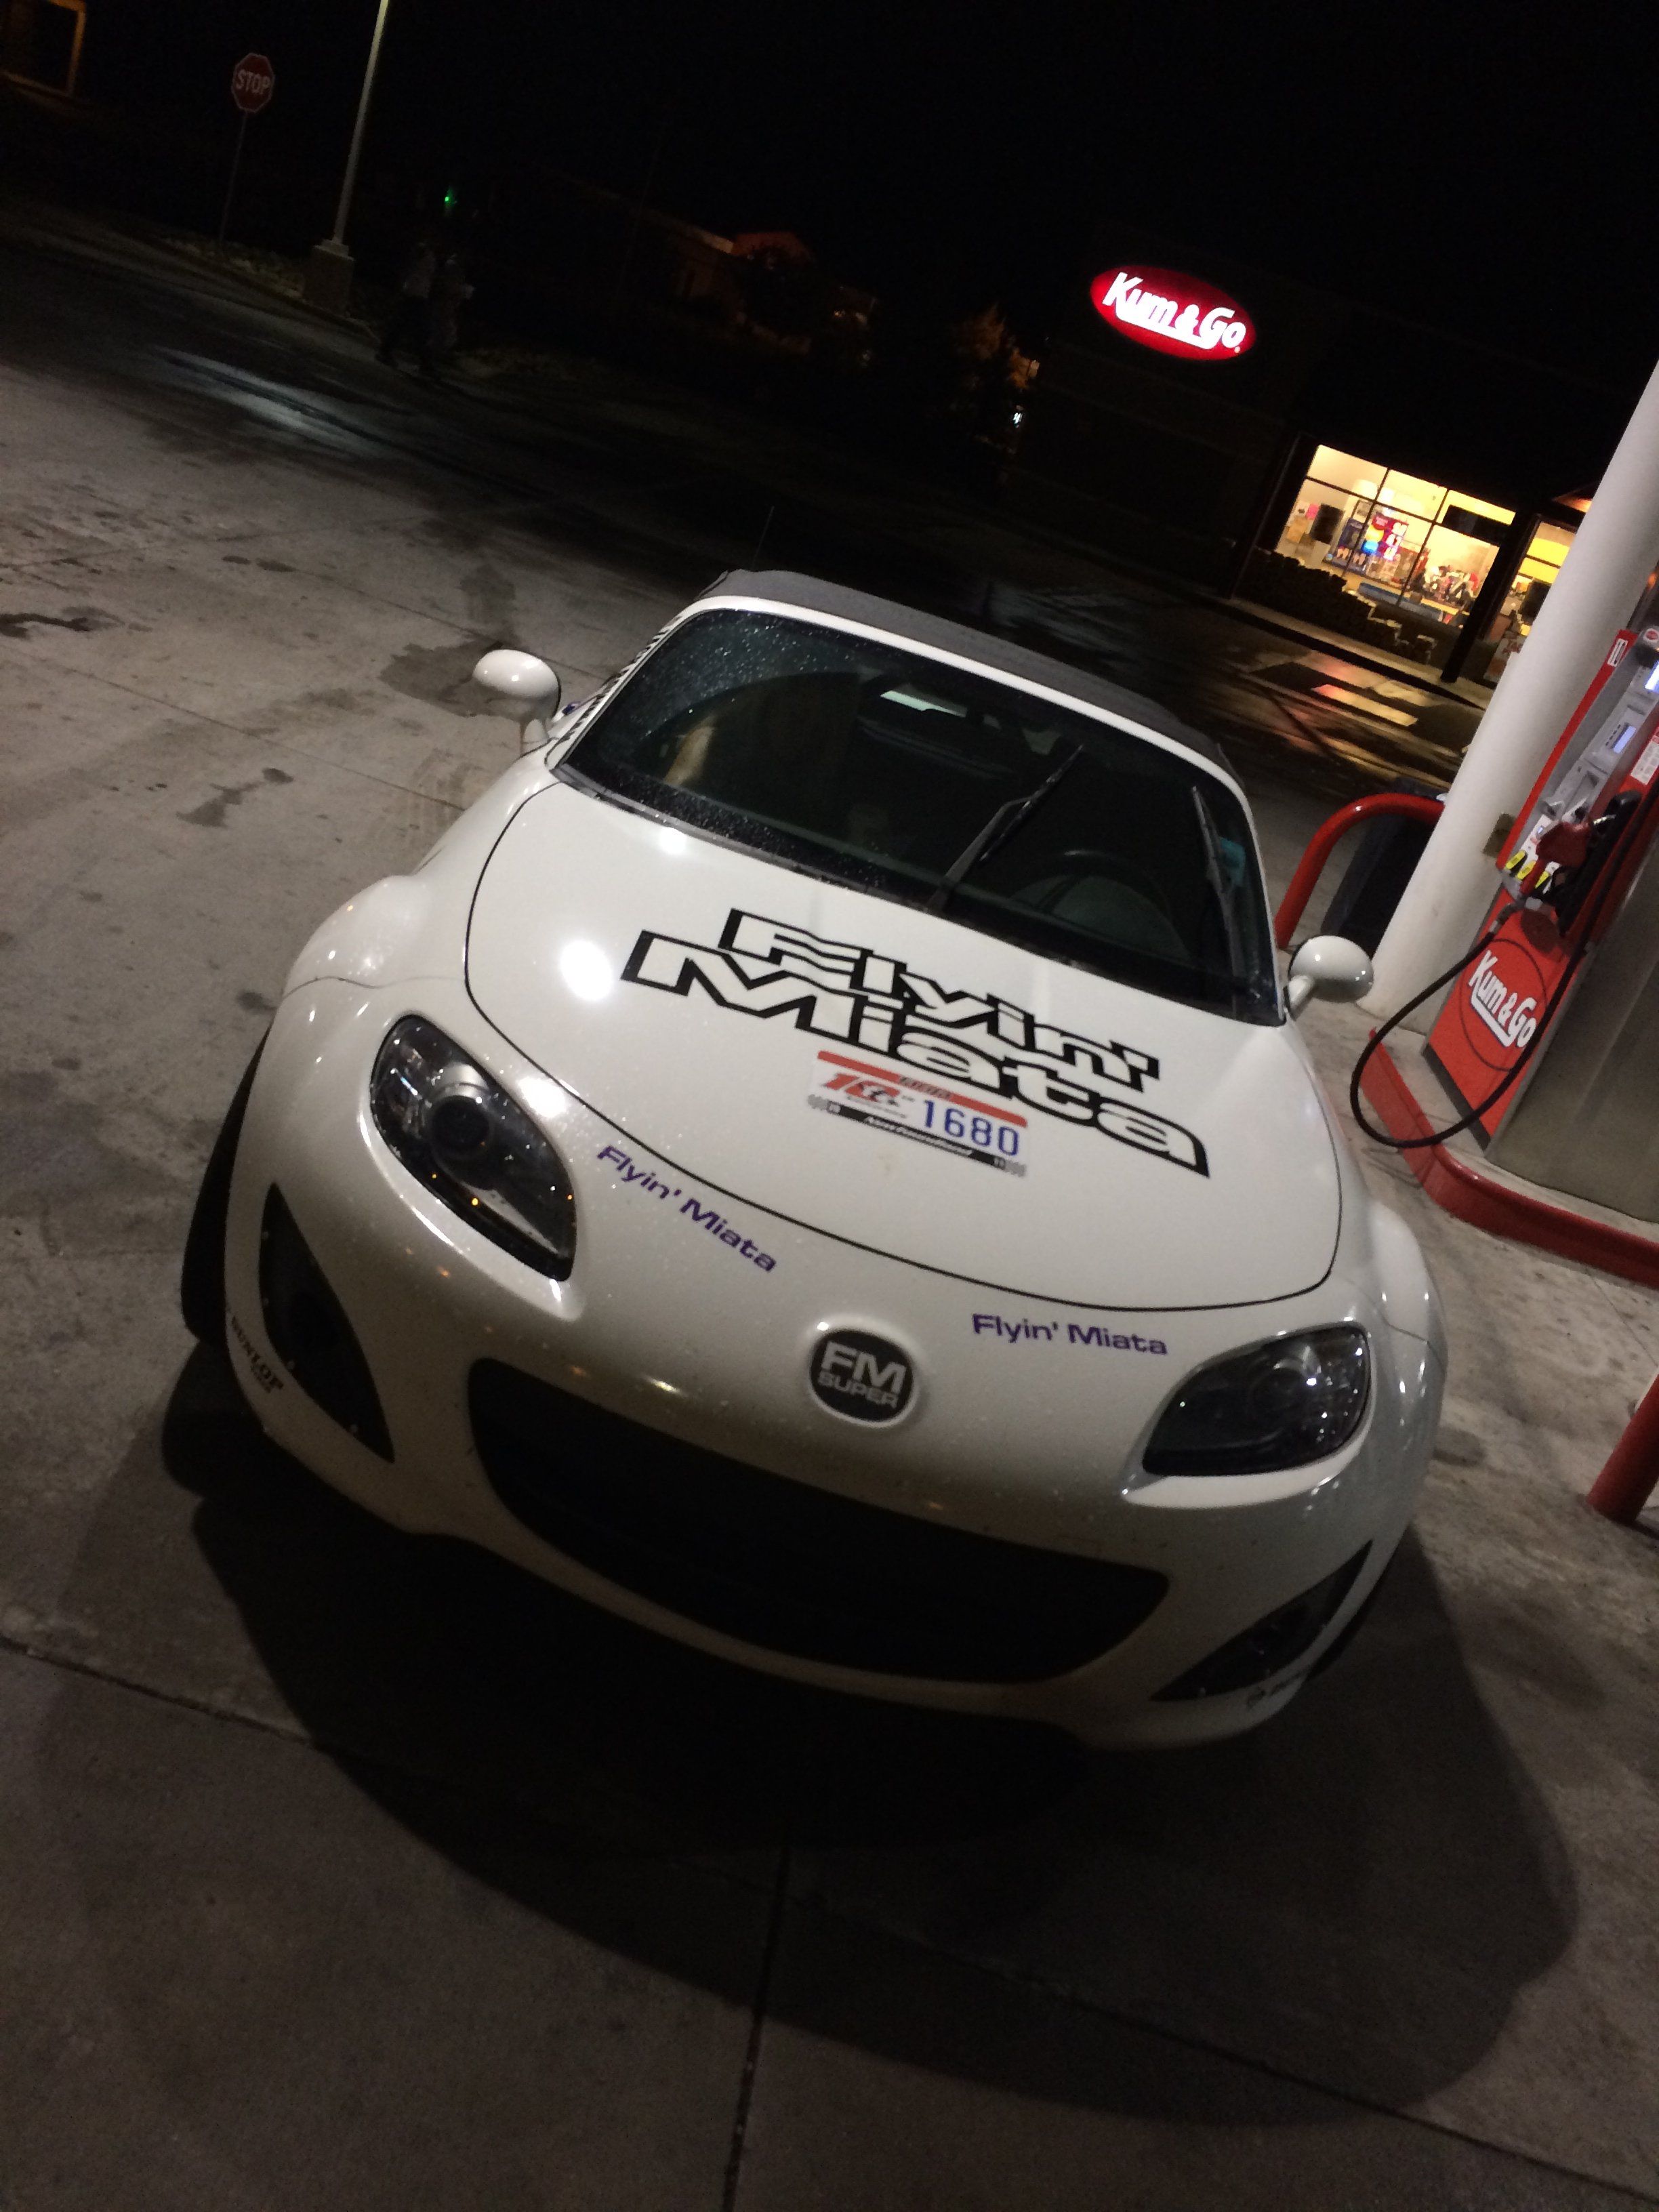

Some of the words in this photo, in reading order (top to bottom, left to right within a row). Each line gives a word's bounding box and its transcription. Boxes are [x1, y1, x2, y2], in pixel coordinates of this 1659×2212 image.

[236, 69, 271, 94] STOP
[718, 908, 1160, 1092] Flyin'
[620, 930, 1210, 1177] Miata
[924, 1099, 1019, 1156] 1680
[597, 1145, 681, 1200] Flyin'
[680, 1198, 777, 1271] Miata
[972, 1313, 1059, 1343] Flyin'
[1068, 1323, 1167, 1355] Miata
[817, 1370, 899, 1410] SUPER
[821, 1340, 907, 1395] FM
